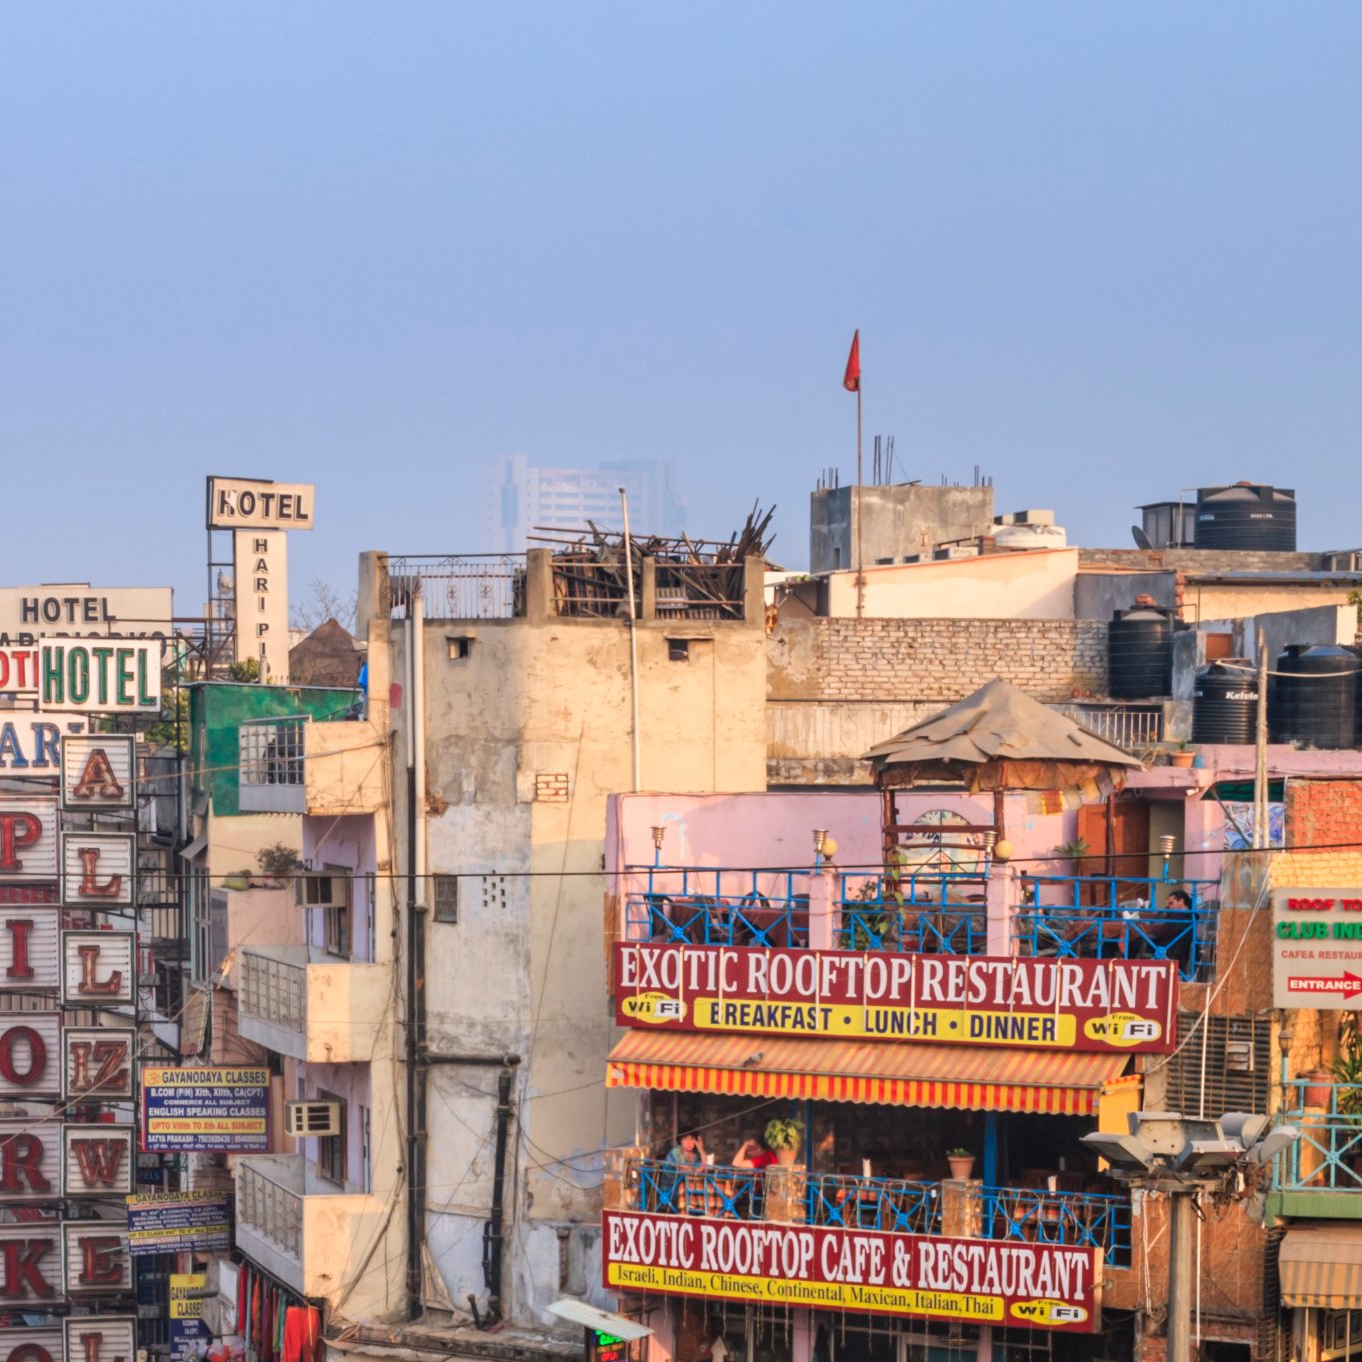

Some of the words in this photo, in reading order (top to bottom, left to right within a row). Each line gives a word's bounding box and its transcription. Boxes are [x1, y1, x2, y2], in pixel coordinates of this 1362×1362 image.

[254, 538, 269, 611] HARI
[22, 597, 116, 623] HOTEL
[43, 646, 157, 706] HOTEL
[1225, 691, 1259, 700] Kelvin
[1288, 898, 1335, 910] ROOF
[1277, 921, 1328, 939] CLUB
[620, 948, 738, 991] EXOTIC
[748, 951, 911, 1000] ROOFTOP
[920, 958, 1166, 1009] RESTAURANT
[1290, 981, 1361, 990] ENTRANCE
[711, 1005, 832, 1030] BREAKFAST
[864, 1010, 937, 1036] LUNCH
[971, 1015, 1055, 1042] DINNER
[162, 1071, 222, 1084] GAYANODAYA
[225, 1071, 266, 1084] CLASSES
[148, 1107, 185, 1117] ENGLISH
[186, 1107, 228, 1117] SPEAKING
[229, 1107, 266, 1117] CLASSES
[217, 1121, 230, 1130] ALL
[231, 1121, 263, 1130] SUBJECT
[608, 1217, 693, 1264] EXOTIC
[702, 1225, 814, 1279] ROOFTOP
[822, 1234, 886, 1284] CAFE
[919, 1242, 1089, 1300] RESTAURANT
